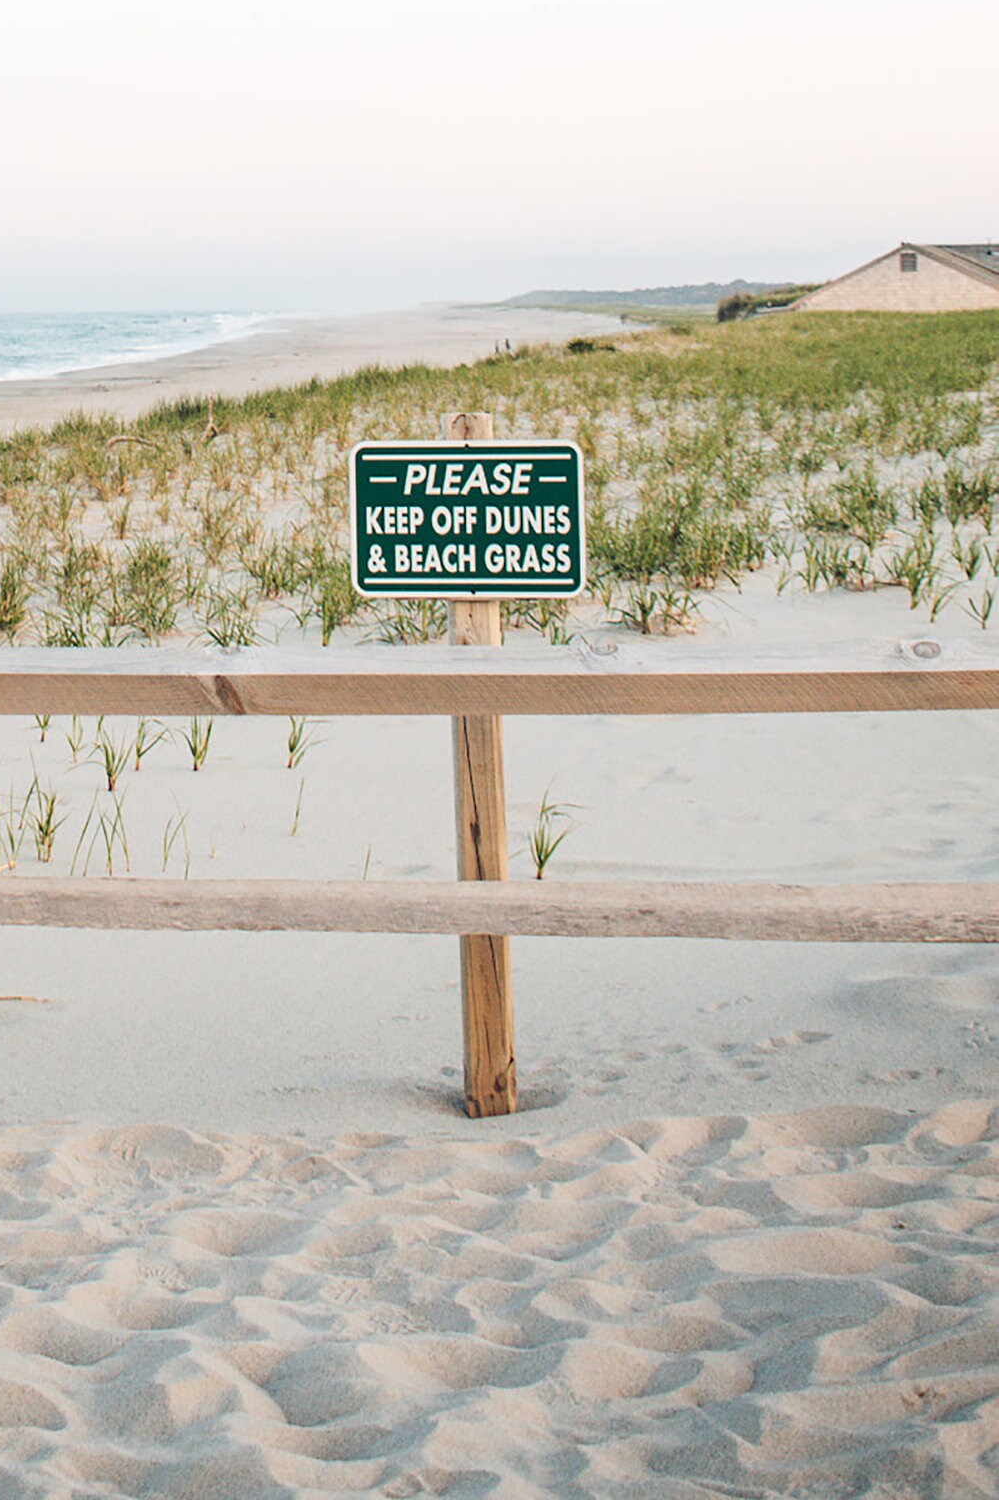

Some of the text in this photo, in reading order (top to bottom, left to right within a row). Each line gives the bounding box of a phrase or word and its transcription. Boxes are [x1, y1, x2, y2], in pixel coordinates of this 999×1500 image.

[403, 463, 533, 495] PLEASE
[366, 505, 571, 535] KEEP OFF DUNES
[367, 543, 571, 573] & BEACH GRASS
